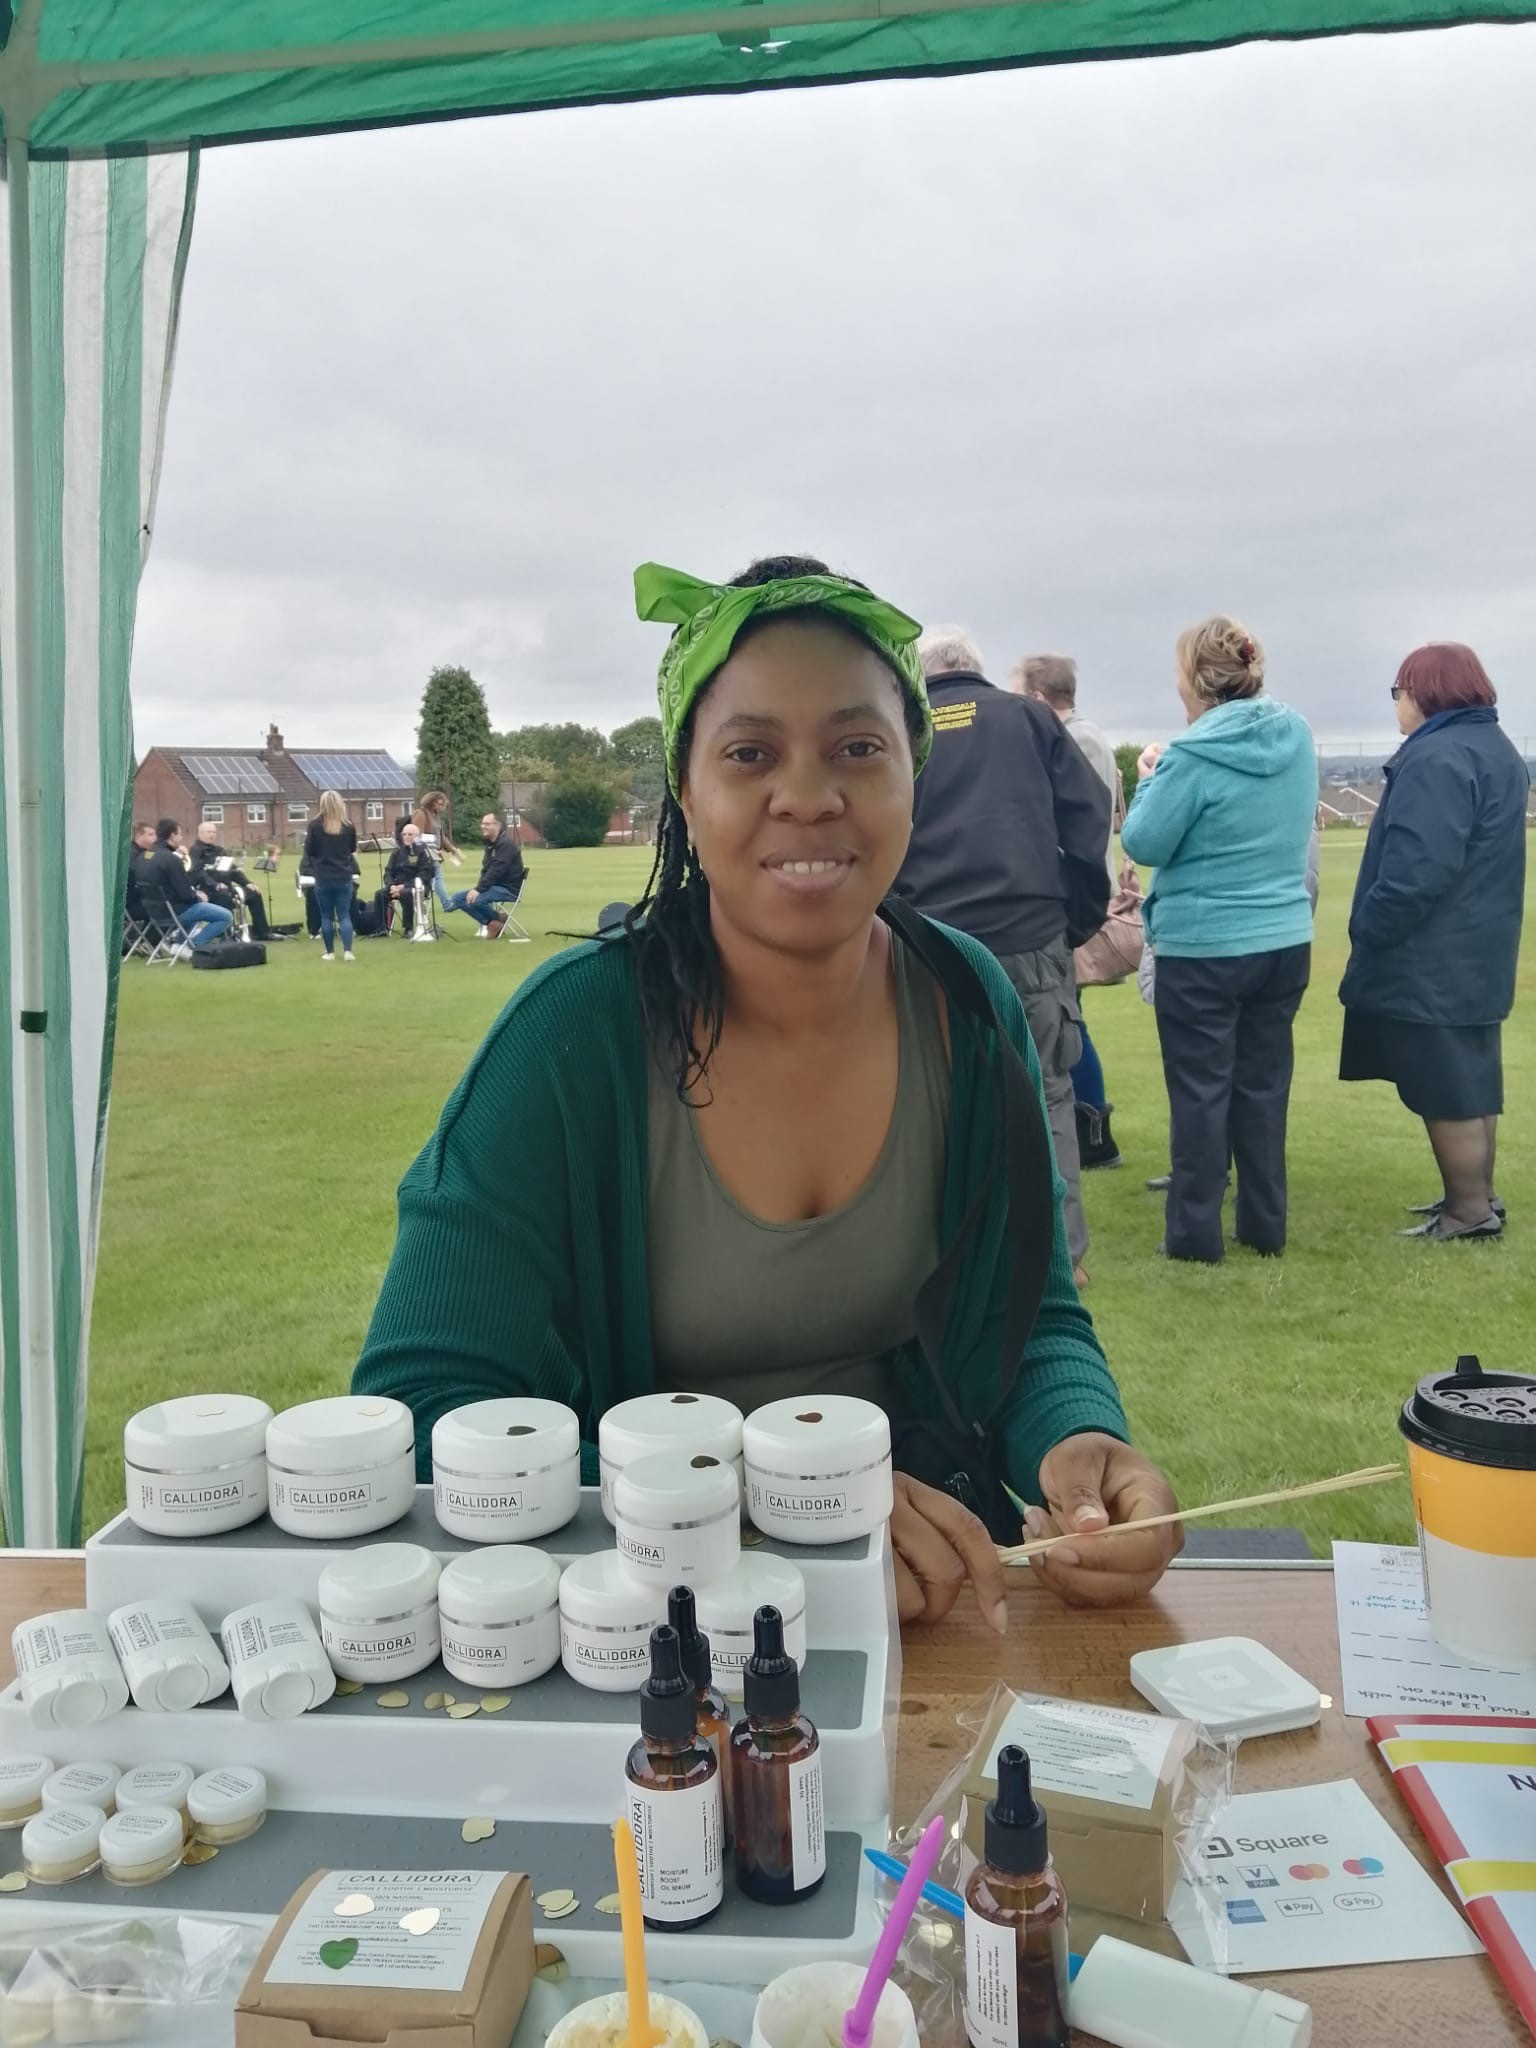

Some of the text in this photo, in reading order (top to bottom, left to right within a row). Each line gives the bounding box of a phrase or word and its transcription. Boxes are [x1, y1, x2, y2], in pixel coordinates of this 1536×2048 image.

[164, 1485, 239, 1504] CALLIDORA
[293, 1489, 366, 1504] CALLIDORA
[448, 1493, 517, 1509] CALLIDORA
[769, 1495, 841, 1510] CALLIDORA
[342, 1636, 412, 1653] CALLIDORA
[444, 1637, 502, 1659] CALLIDORA
[577, 1646, 646, 1661] CALLIDORA
[1358, 1690, 1392, 1699] with
[1397, 1685, 1423, 1693] on.
[1400, 1696, 1453, 1707] stones
[1488, 1705, 1530, 1716] Find
[1236, 1833, 1328, 1854] Square
[349, 1875, 472, 1883] CALLIDORA
[1252, 1879, 1271, 1887] PAY
[1293, 1902, 1314, 1912] Pay
